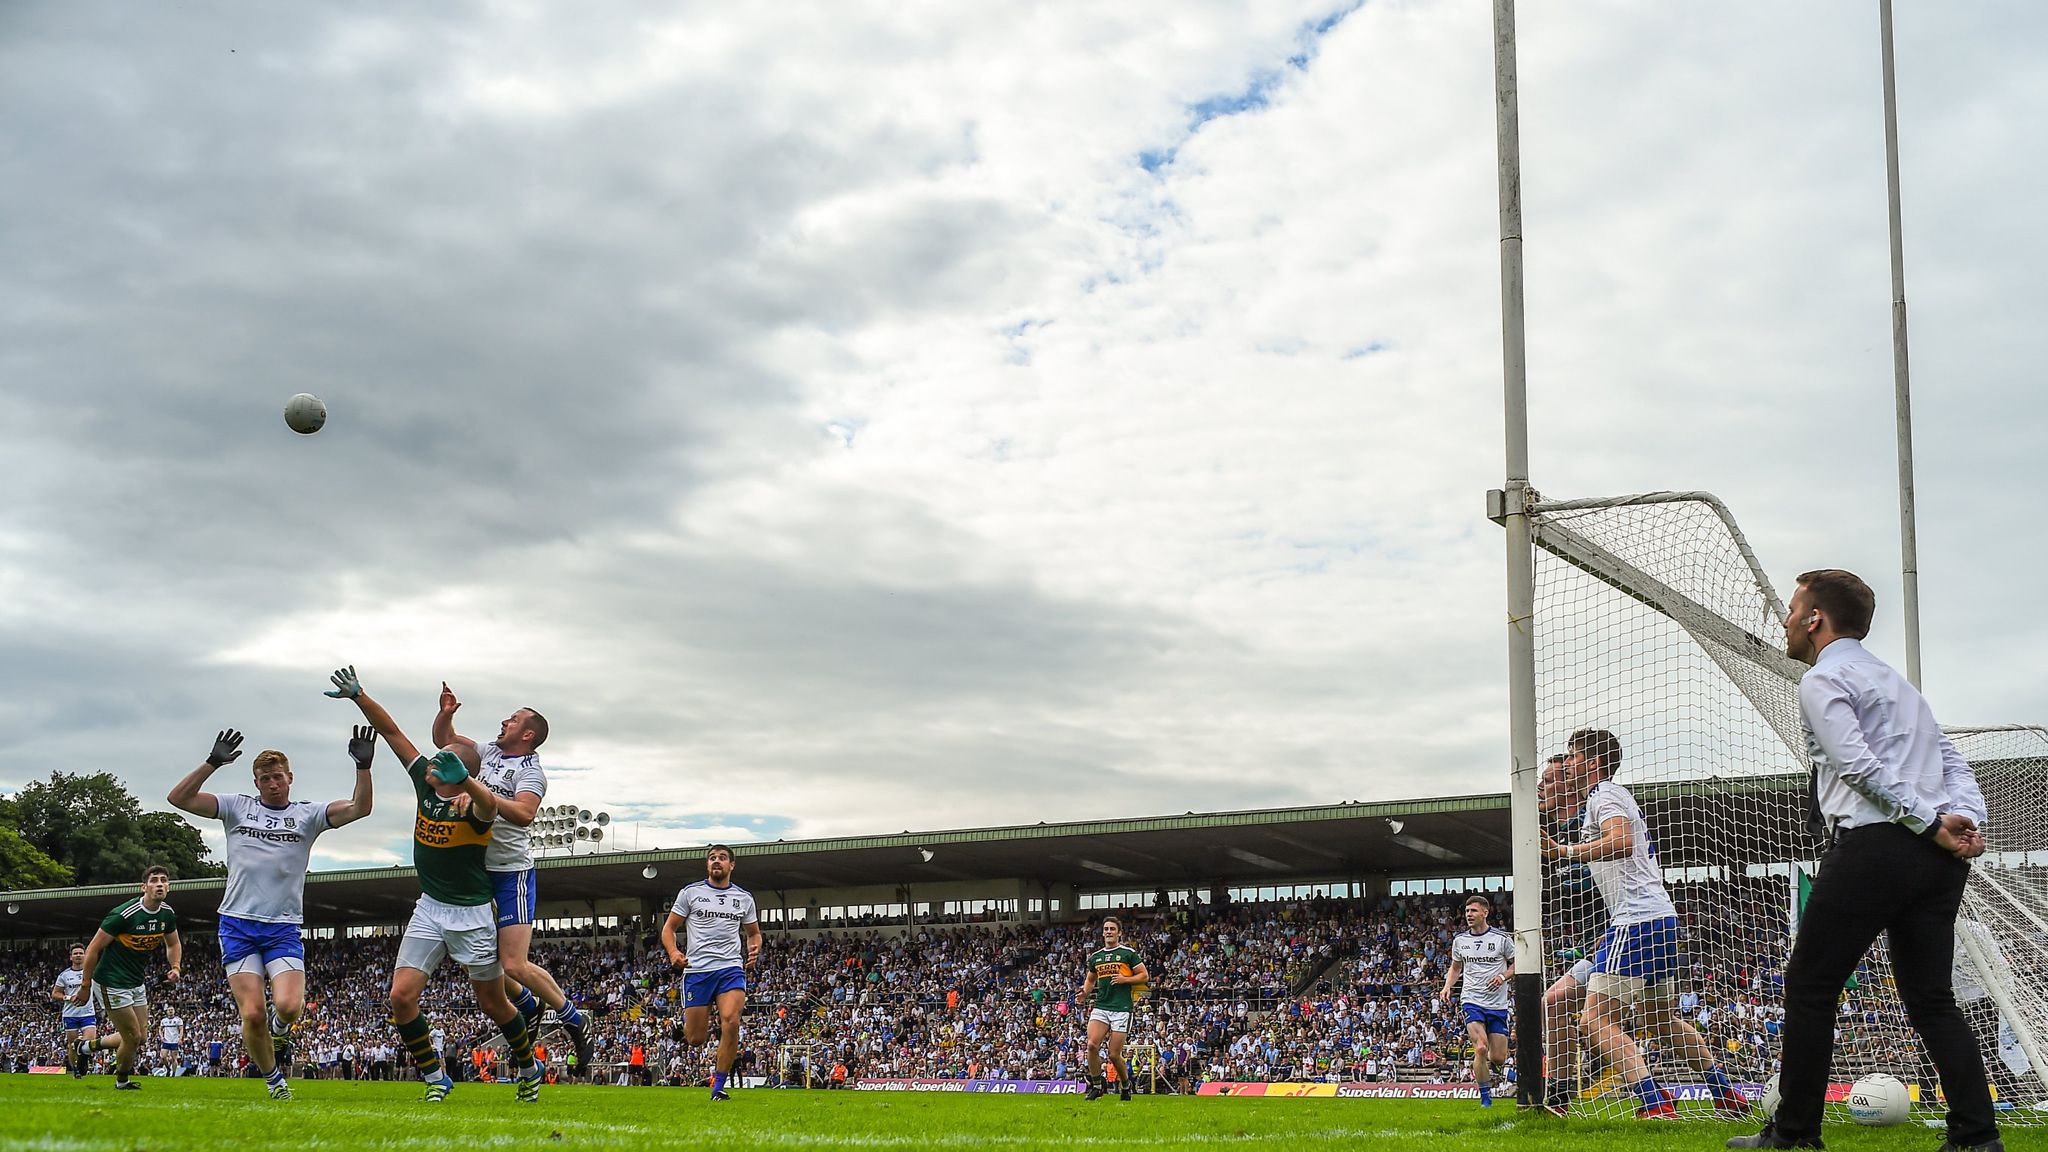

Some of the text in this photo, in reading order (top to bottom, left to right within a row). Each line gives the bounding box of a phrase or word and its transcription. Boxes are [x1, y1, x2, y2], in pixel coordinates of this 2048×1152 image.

[265, 820, 278, 829] 21
[248, 828, 300, 843] Investec
[855, 1080, 907, 1091] SuperValu
[909, 1081, 965, 1092] SuperValu
[1337, 1086, 1407, 1098] SuperValu
[1410, 1087, 1481, 1099] SuperValu
